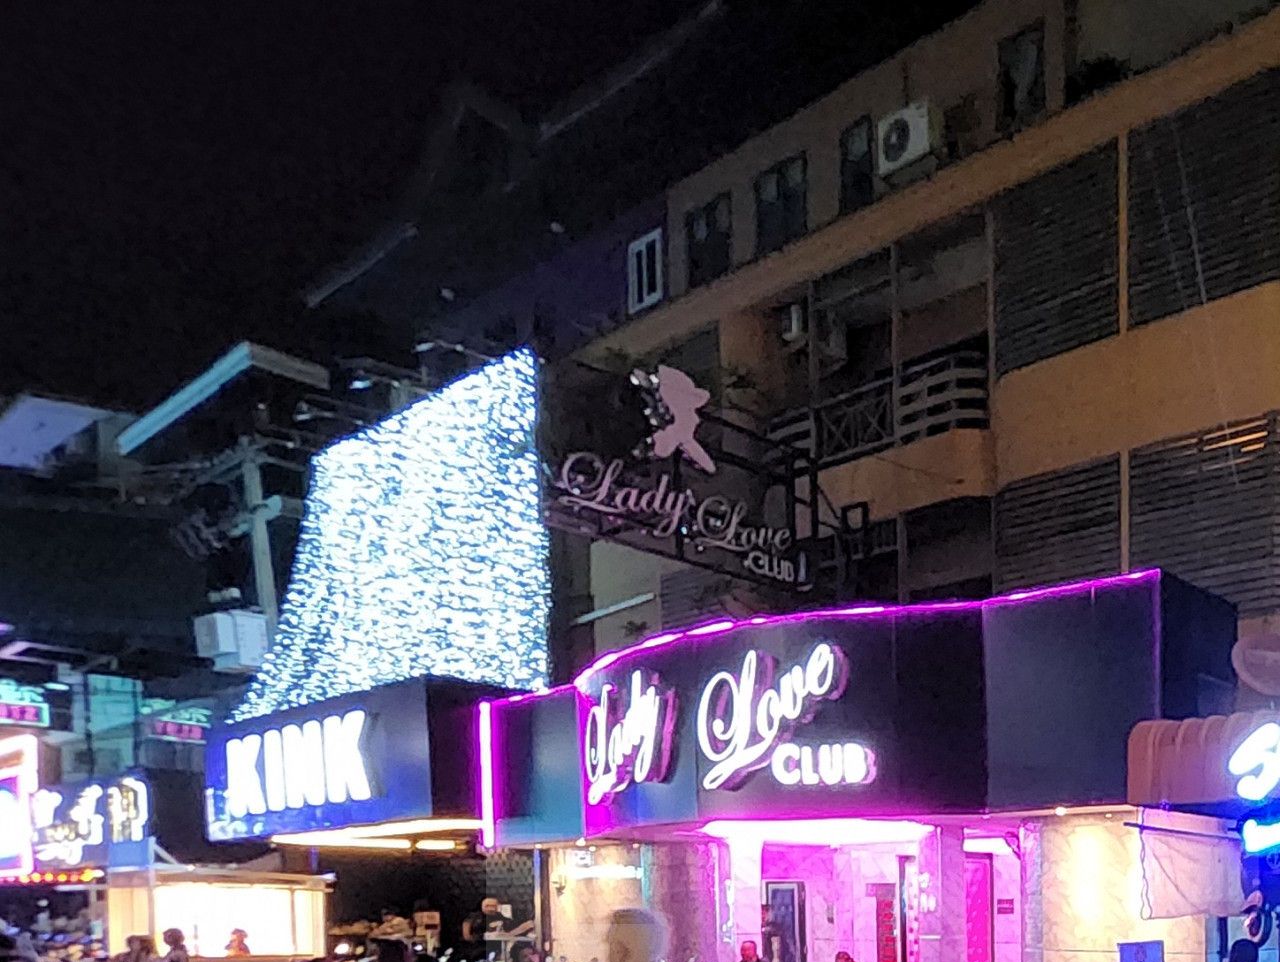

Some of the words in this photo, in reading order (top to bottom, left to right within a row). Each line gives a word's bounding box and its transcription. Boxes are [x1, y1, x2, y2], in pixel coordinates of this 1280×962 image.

[557, 451, 696, 538] Lady
[694, 495, 792, 551] Love
[225, 709, 373, 819] KINK
[696, 643, 836, 791] Love
[770, 742, 870, 786] CLUB
